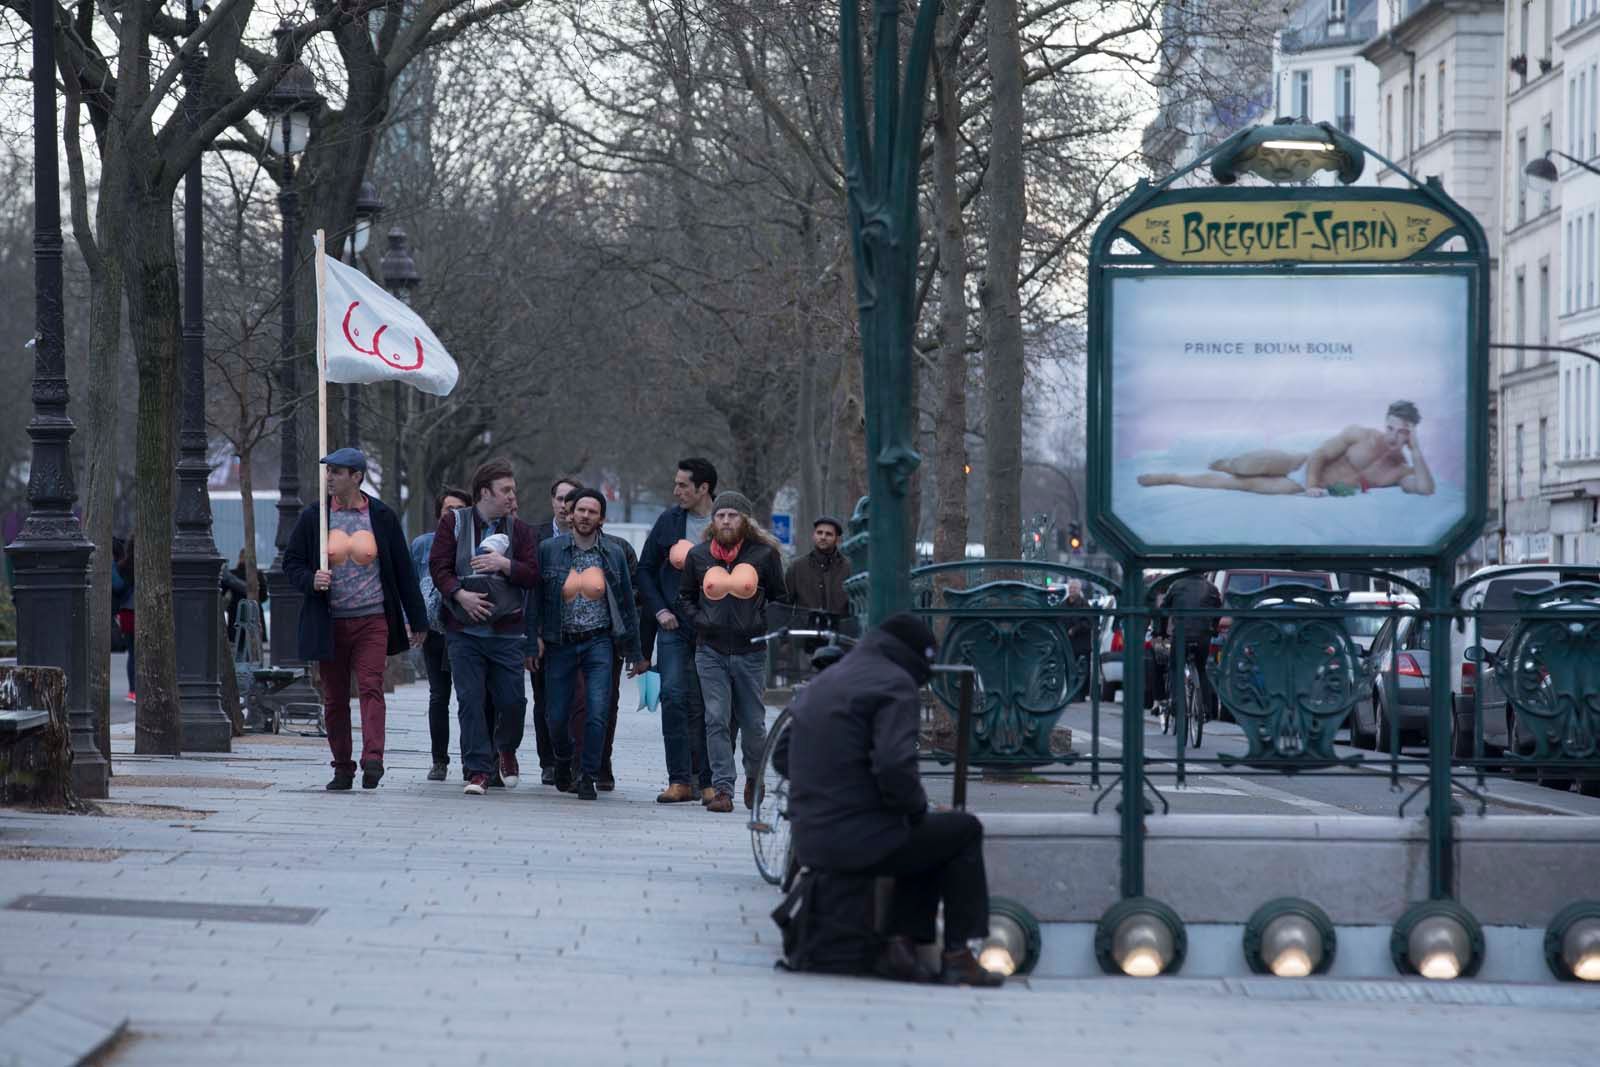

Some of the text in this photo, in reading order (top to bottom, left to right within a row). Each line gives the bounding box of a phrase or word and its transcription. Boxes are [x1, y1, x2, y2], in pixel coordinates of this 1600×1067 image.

[1184, 342, 1353, 355] PRINCE BOUM BOUM
